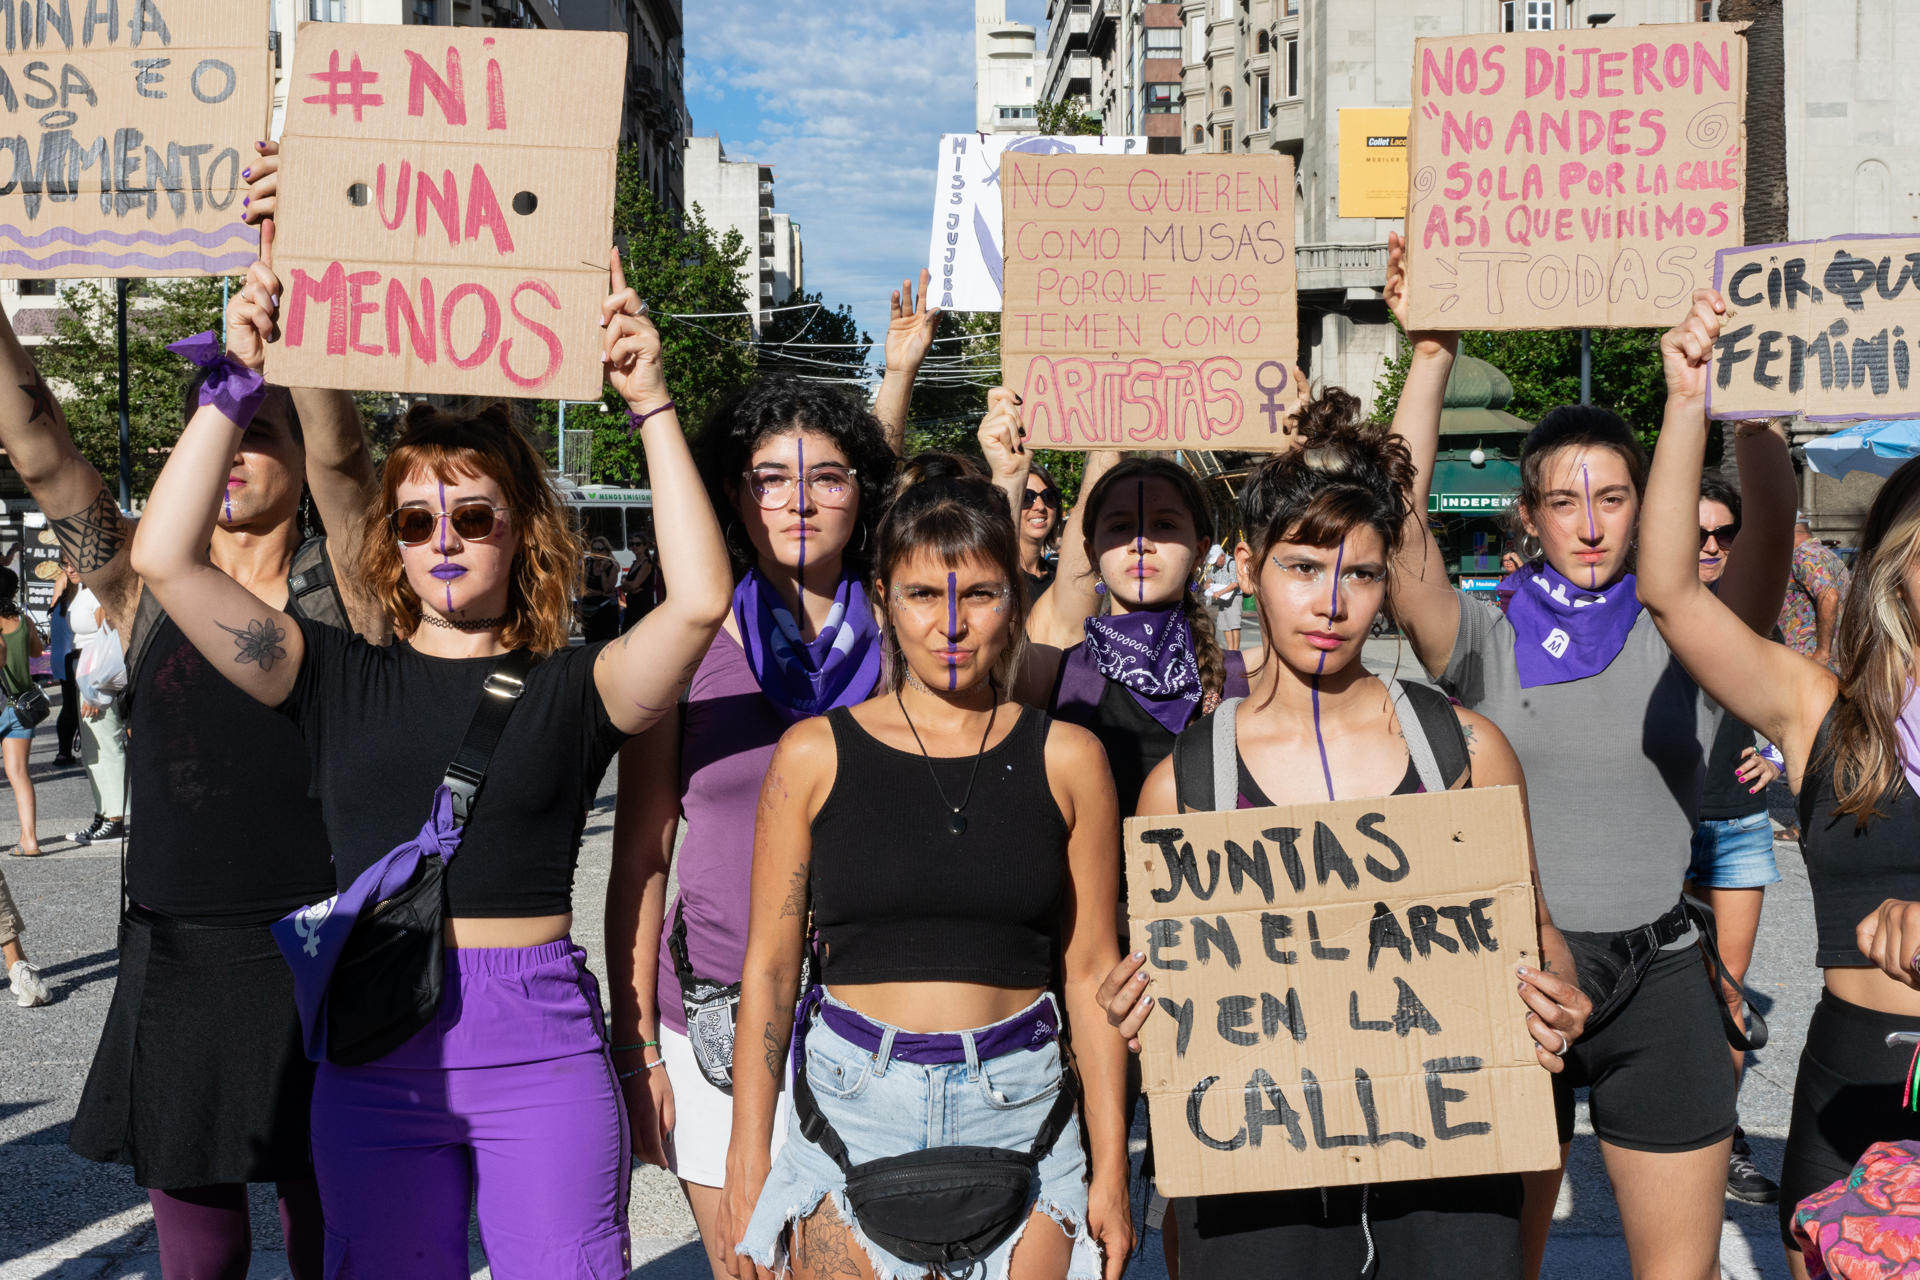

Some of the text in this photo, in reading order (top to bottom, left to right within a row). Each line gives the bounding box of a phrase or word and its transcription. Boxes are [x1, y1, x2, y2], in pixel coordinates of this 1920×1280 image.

[191, 59, 237, 104] O
[1422, 44, 1506, 97] NOS
[1505, 109, 1667, 157] ANDES
[950, 137, 967, 205] MISS
[1013, 163, 1106, 212] NOS
[1443, 161, 1543, 201] SOLA
[1559, 161, 1626, 201] POR
[1636, 164, 1667, 196] LA
[376, 159, 515, 256] UNA
[1505, 204, 1575, 248] QUE
[1017, 220, 1285, 264] COMO MUSAS
[1036, 268, 1261, 307] PORQUE NOS
[1458, 245, 1698, 315] TODAS
[285, 260, 564, 392] MENOS
[1015, 313, 1262, 349] TEMEN COMO
[1140, 812, 1410, 904] JUNTAS
[1146, 897, 1499, 972] EN EL ARTE
[1158, 976, 1442, 1058] Y EN LA
[1186, 1056, 1492, 1153] CALLE
